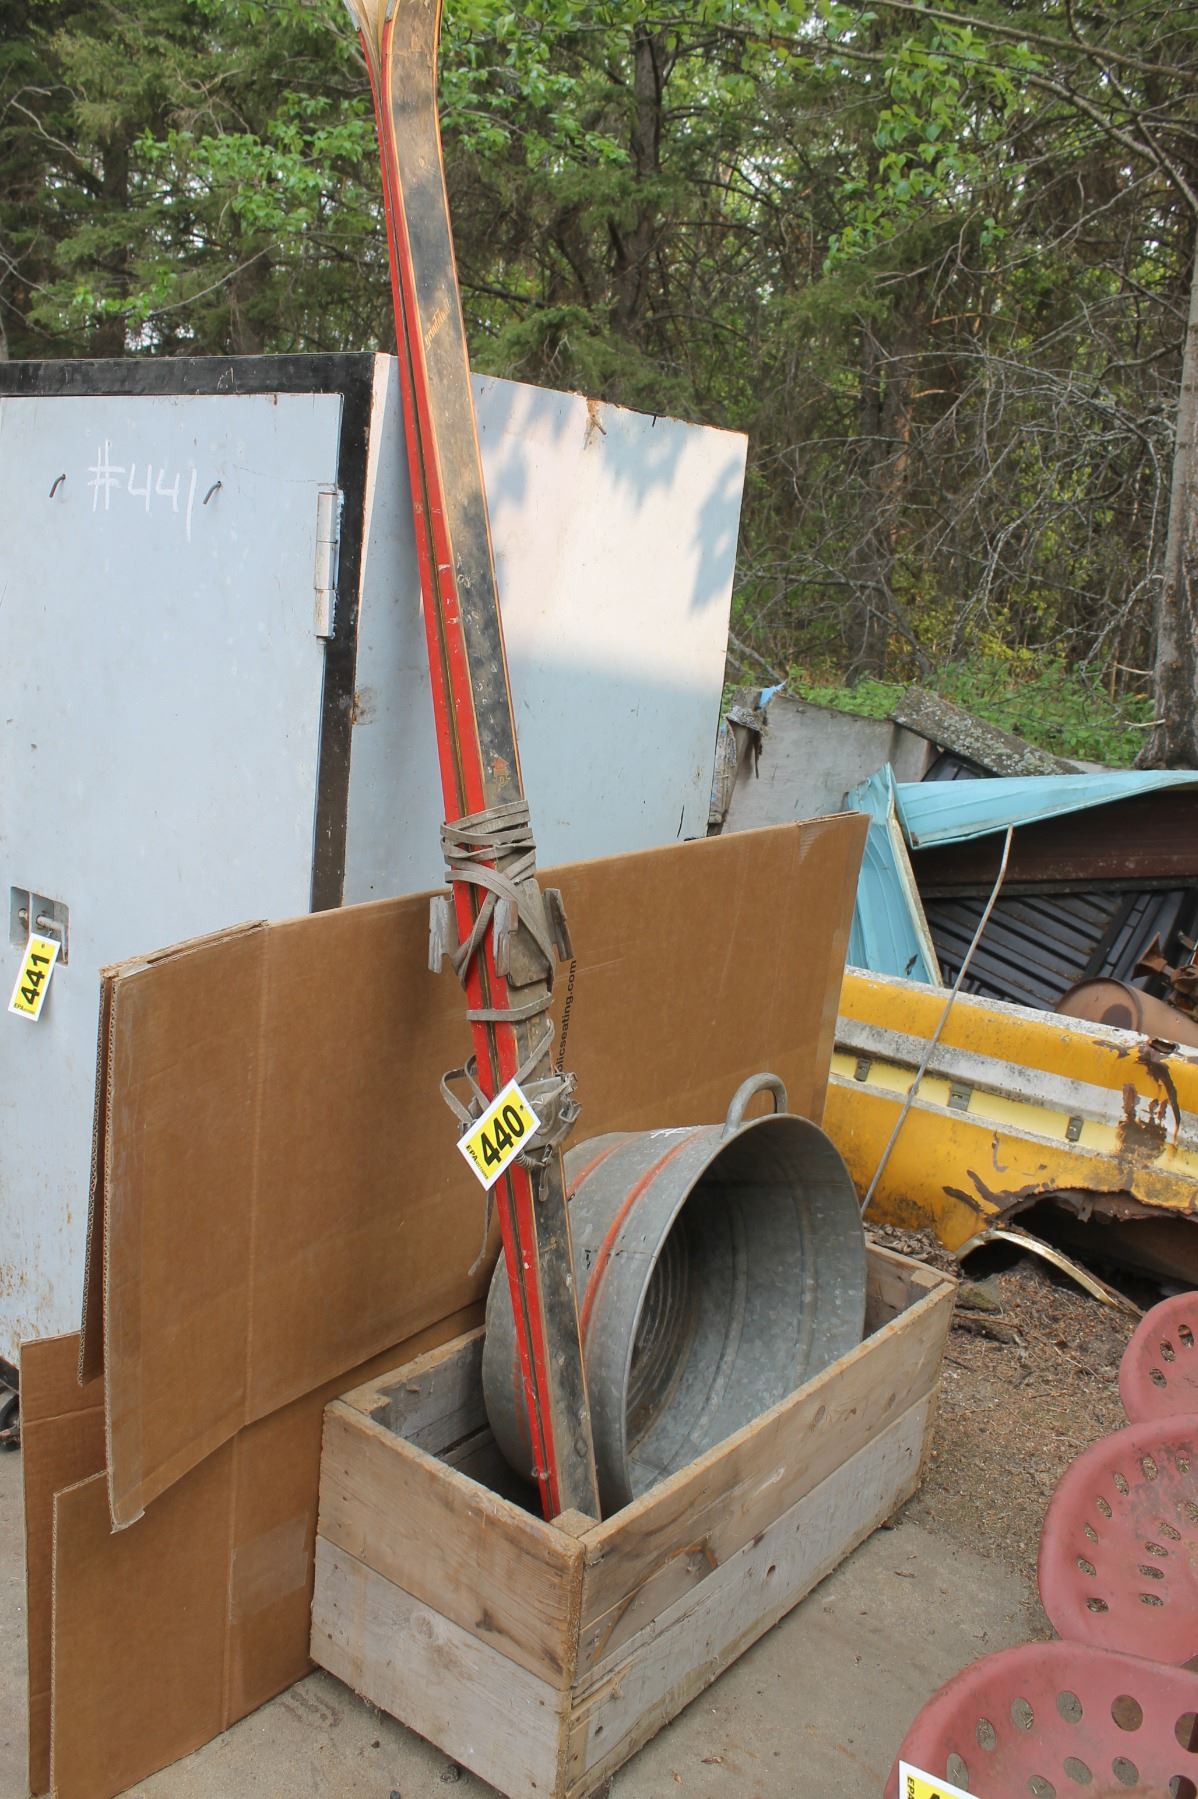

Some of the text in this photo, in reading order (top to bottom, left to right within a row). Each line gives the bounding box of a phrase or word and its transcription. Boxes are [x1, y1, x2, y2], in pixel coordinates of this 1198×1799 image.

[88, 439, 197, 543] #441
[21, 953, 50, 1005] 441
[481, 1104, 525, 1167] 440
